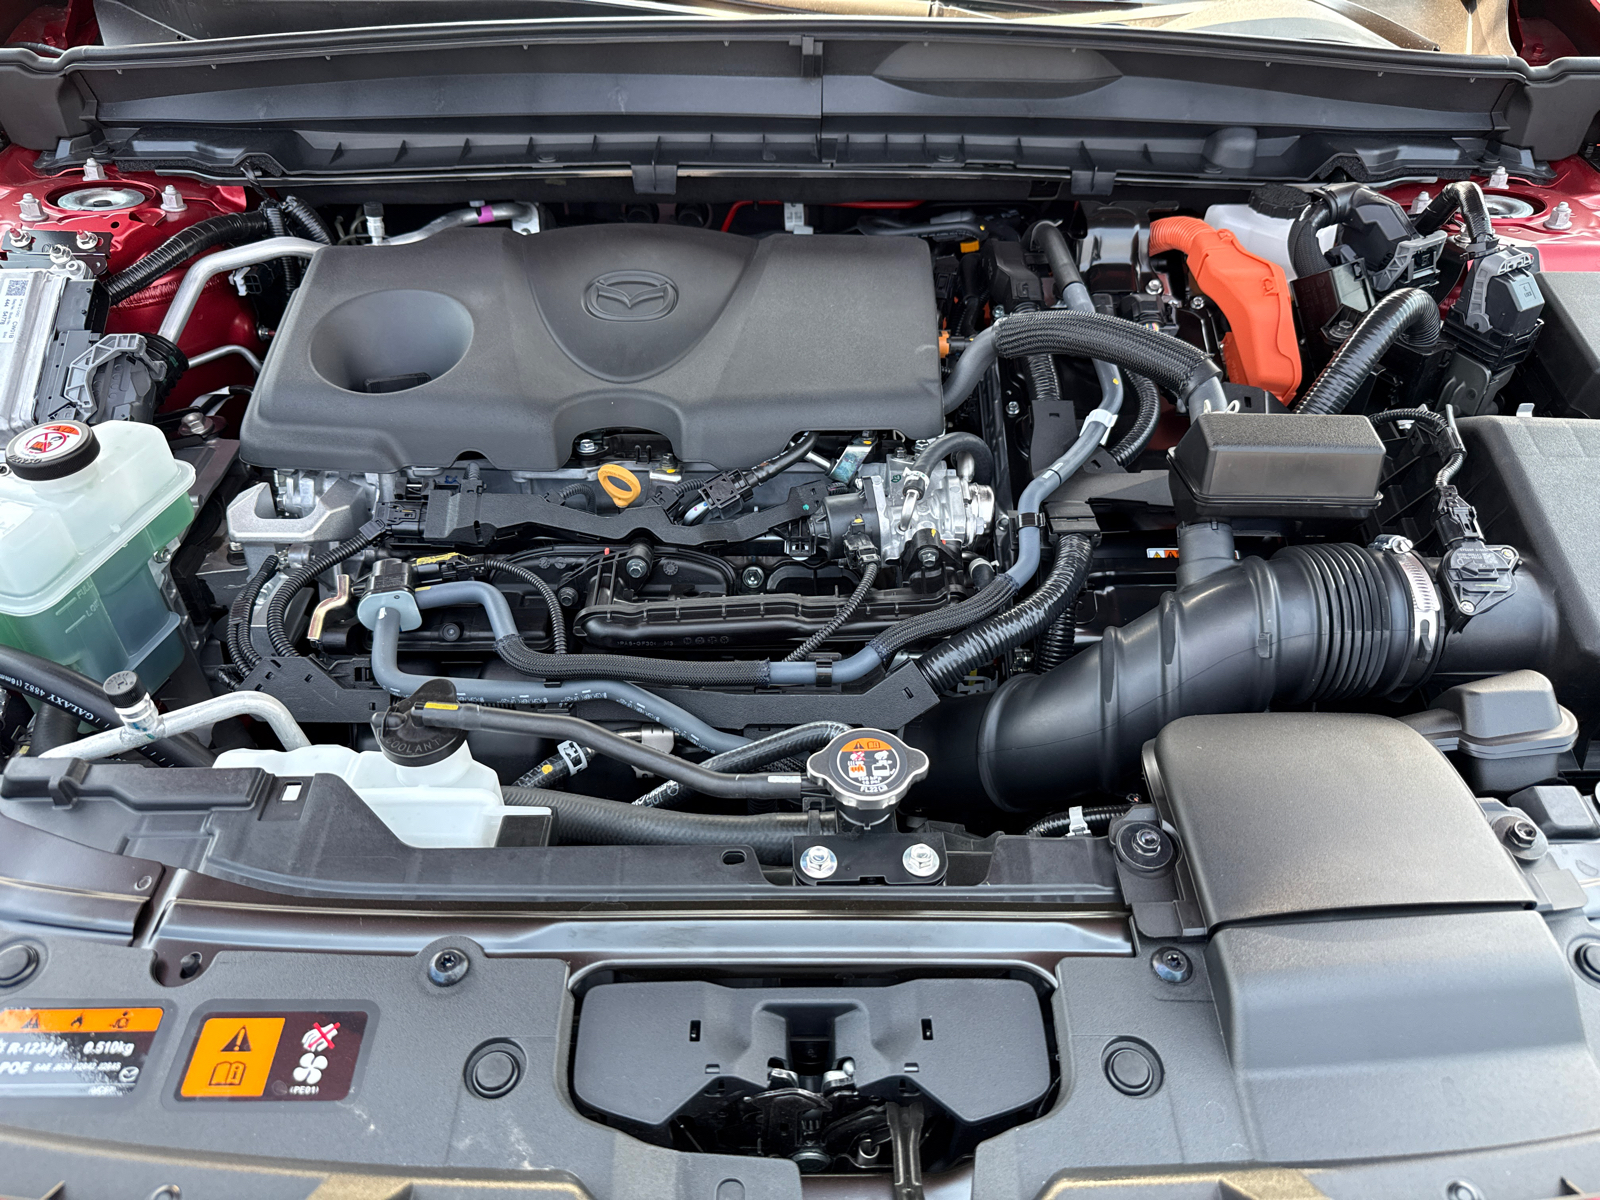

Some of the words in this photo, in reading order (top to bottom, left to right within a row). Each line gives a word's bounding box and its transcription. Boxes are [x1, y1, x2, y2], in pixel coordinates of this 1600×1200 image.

[8, 454, 42, 465] DENSO
[24, 682, 46, 697] 4882
[48, 693, 95, 720] GALAXY
[385, 736, 441, 753] COOLANT
[6, 1041, 68, 1057] R-1234yf
[83, 1040, 135, 1056] 0.510kg
[0, 1061, 31, 1074] POE
